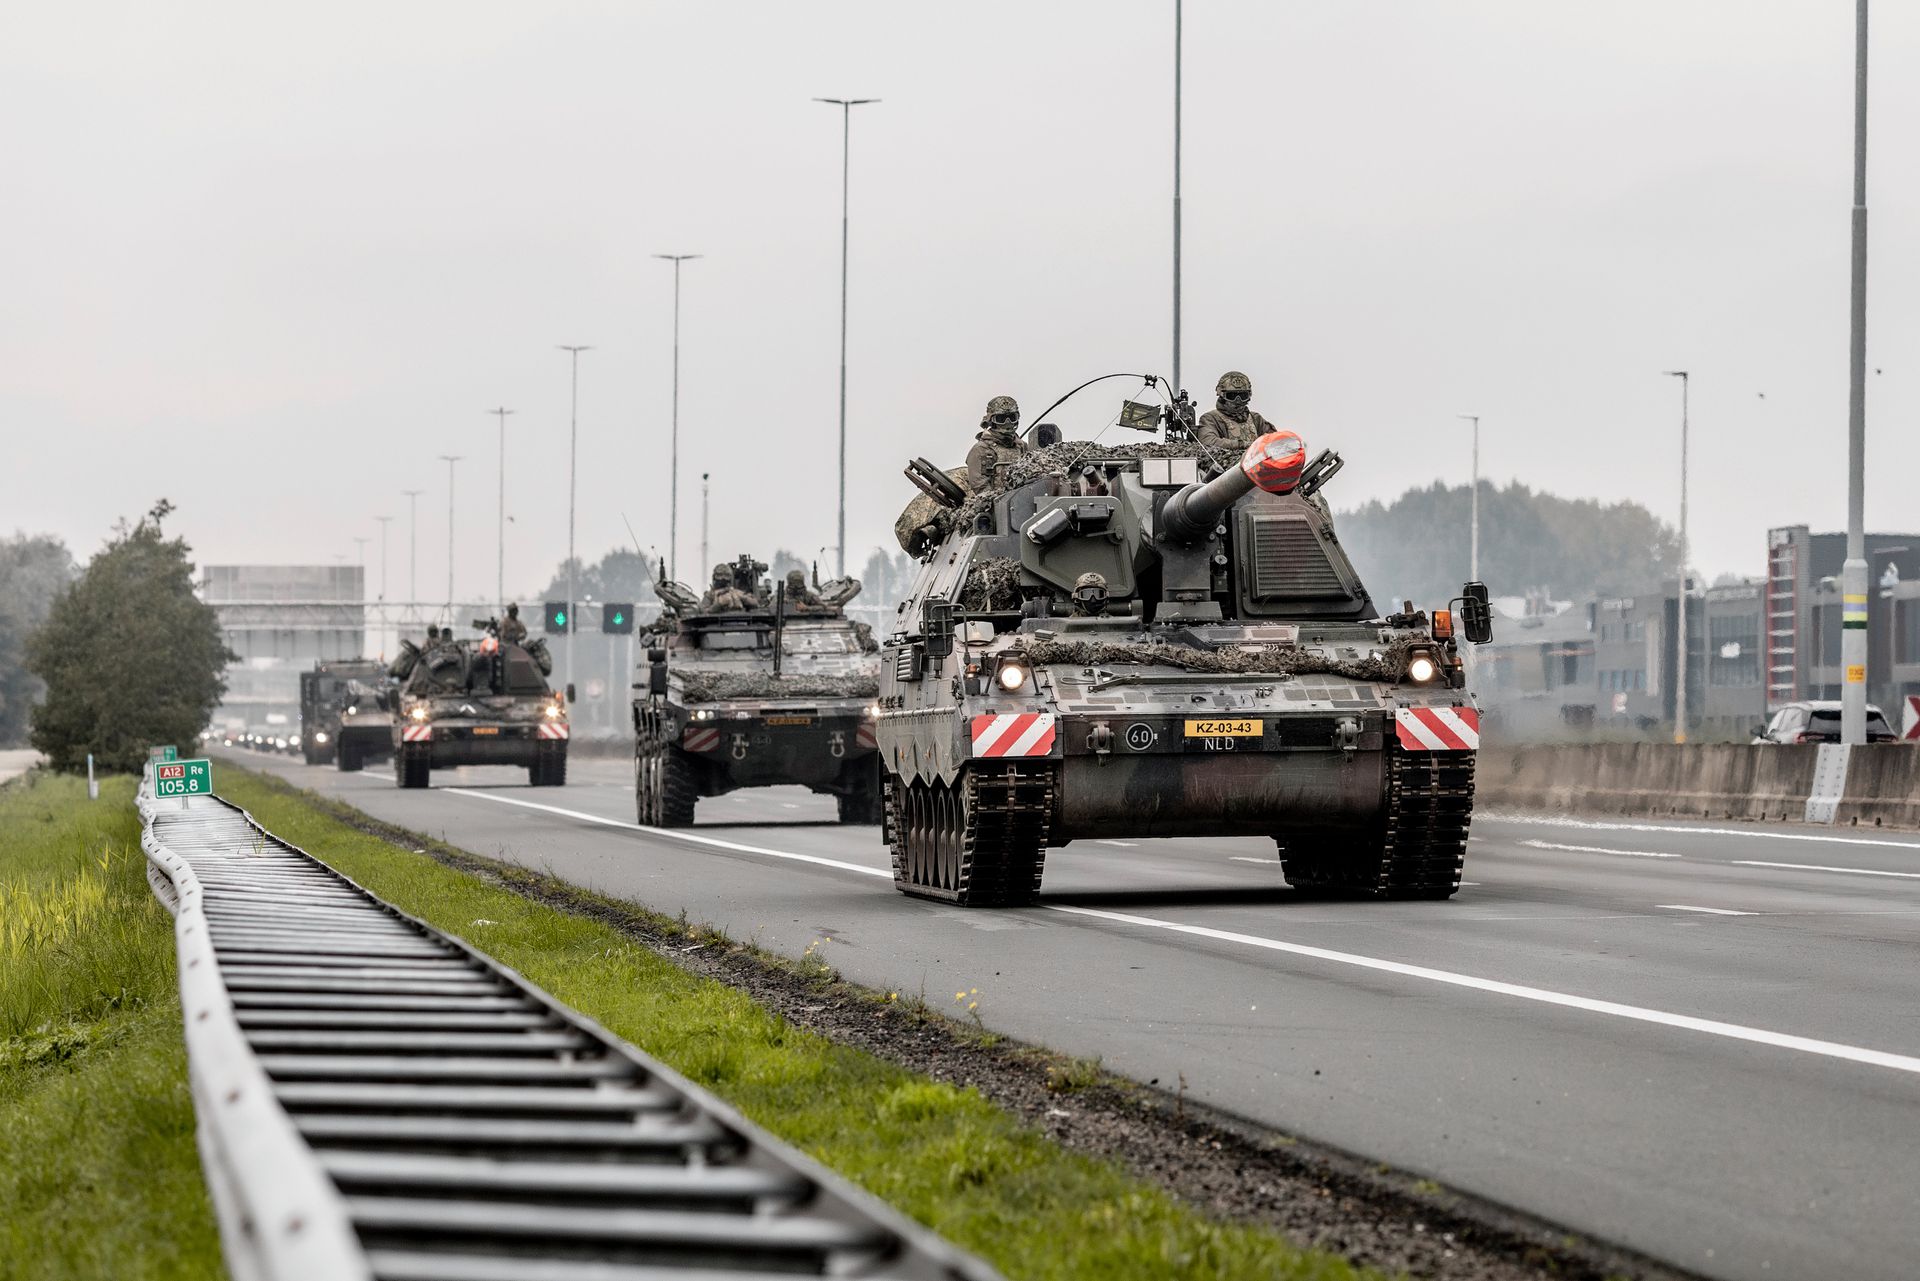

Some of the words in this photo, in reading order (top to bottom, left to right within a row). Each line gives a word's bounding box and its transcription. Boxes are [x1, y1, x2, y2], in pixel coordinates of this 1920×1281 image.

[1196, 722, 1252, 734] KZ-03-43
[1131, 730, 1149, 743] 60
[1204, 737, 1235, 750] NLD
[163, 767, 181, 777] A12
[190, 766, 204, 775] Re
[159, 779, 199, 794] 105.8
